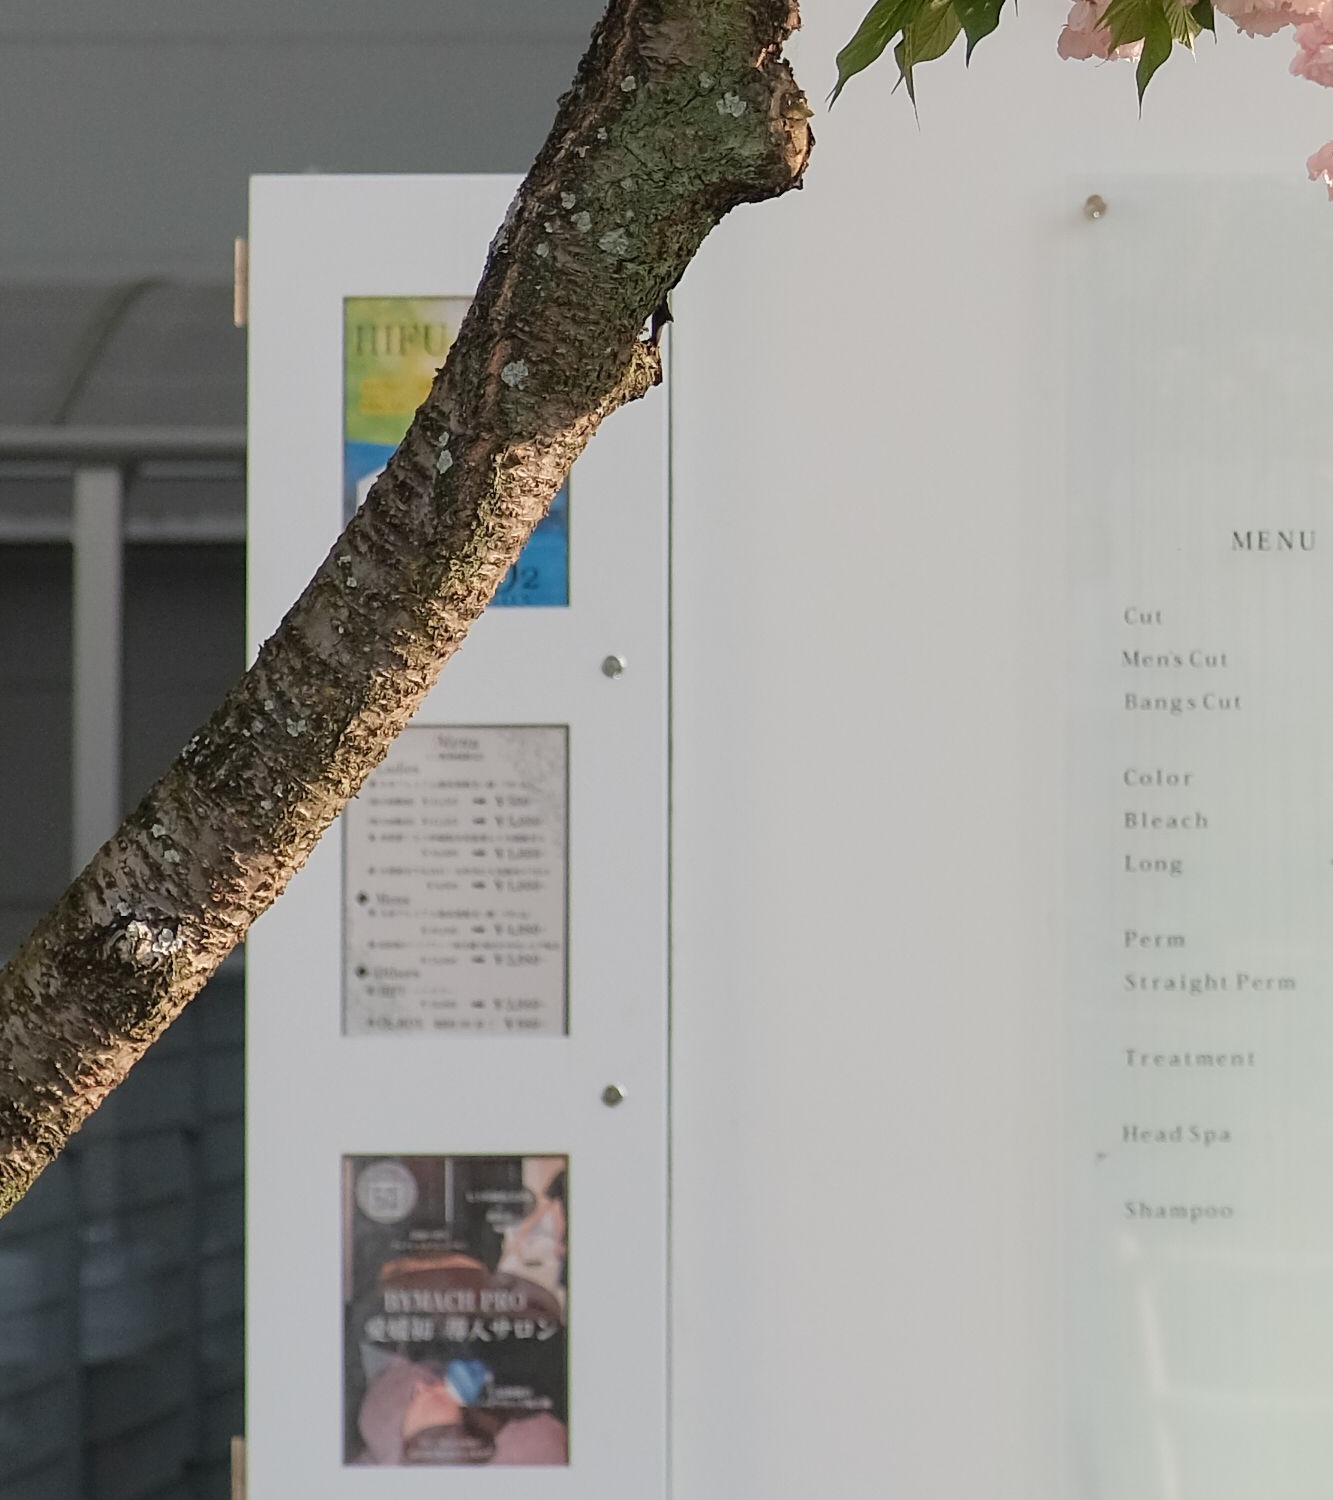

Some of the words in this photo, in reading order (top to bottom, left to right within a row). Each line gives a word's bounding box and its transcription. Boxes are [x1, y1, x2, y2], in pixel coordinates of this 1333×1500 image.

[1232, 531, 1315, 551] MENU
[1123, 607, 1162, 624] Cut
[1188, 650, 1228, 668] Cut
[1124, 692, 1197, 716] Bangs
[1202, 693, 1241, 710] Cut
[1122, 768, 1193, 786] Color
[1123, 811, 1209, 829] Bleach
[1124, 854, 1183, 877] Long
[1123, 929, 1186, 948] Perm
[1124, 973, 1227, 996] Straight
[1235, 973, 1297, 991] Perm
[1122, 1048, 1255, 1067] Treatment
[1122, 1125, 1183, 1143] Head
[1187, 1124, 1232, 1147] Spa
[1123, 1200, 1234, 1224] Shampoo
